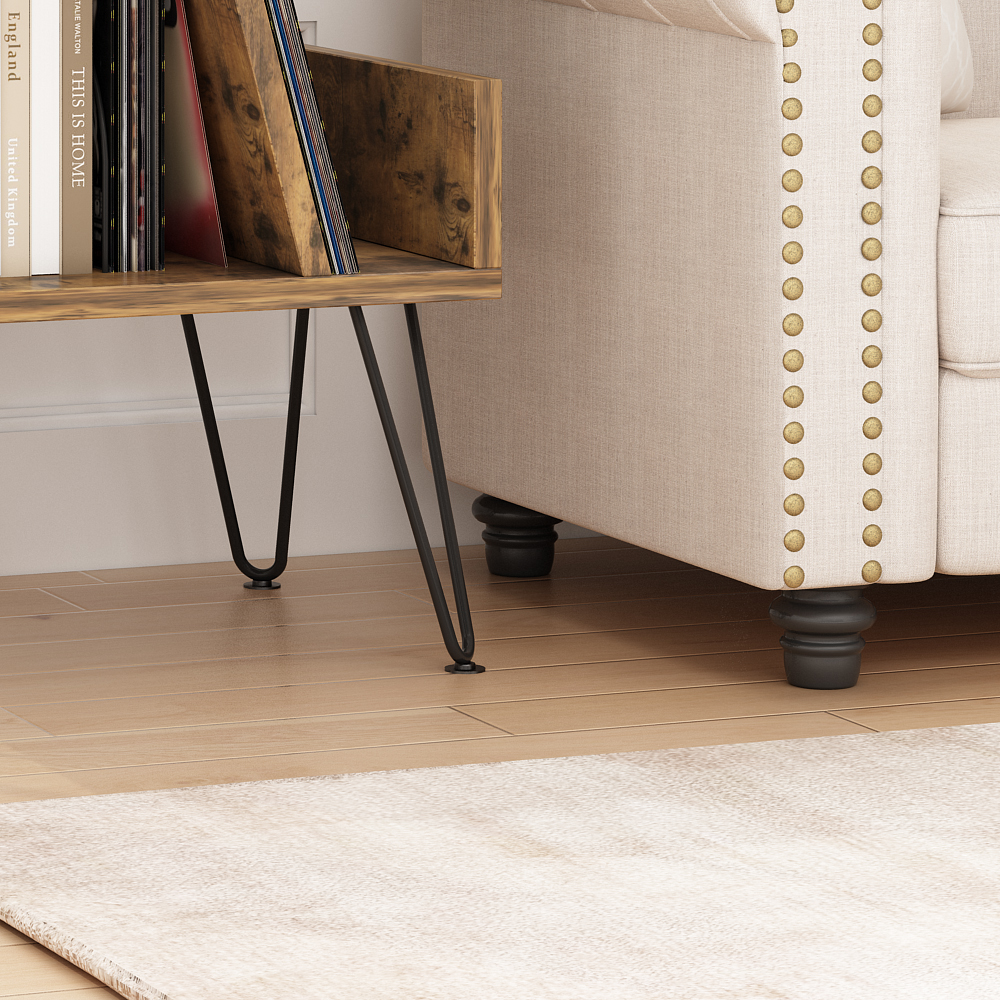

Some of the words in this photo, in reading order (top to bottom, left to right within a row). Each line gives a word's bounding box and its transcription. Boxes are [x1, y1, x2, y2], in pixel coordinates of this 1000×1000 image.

[4, 11, 21, 82] England
[71, 66, 85, 108] THIS
[71, 113, 85, 128] IS
[7, 137, 18, 182] United
[71, 134, 85, 188] HOME
[5, 188, 18, 247] Kingdom
